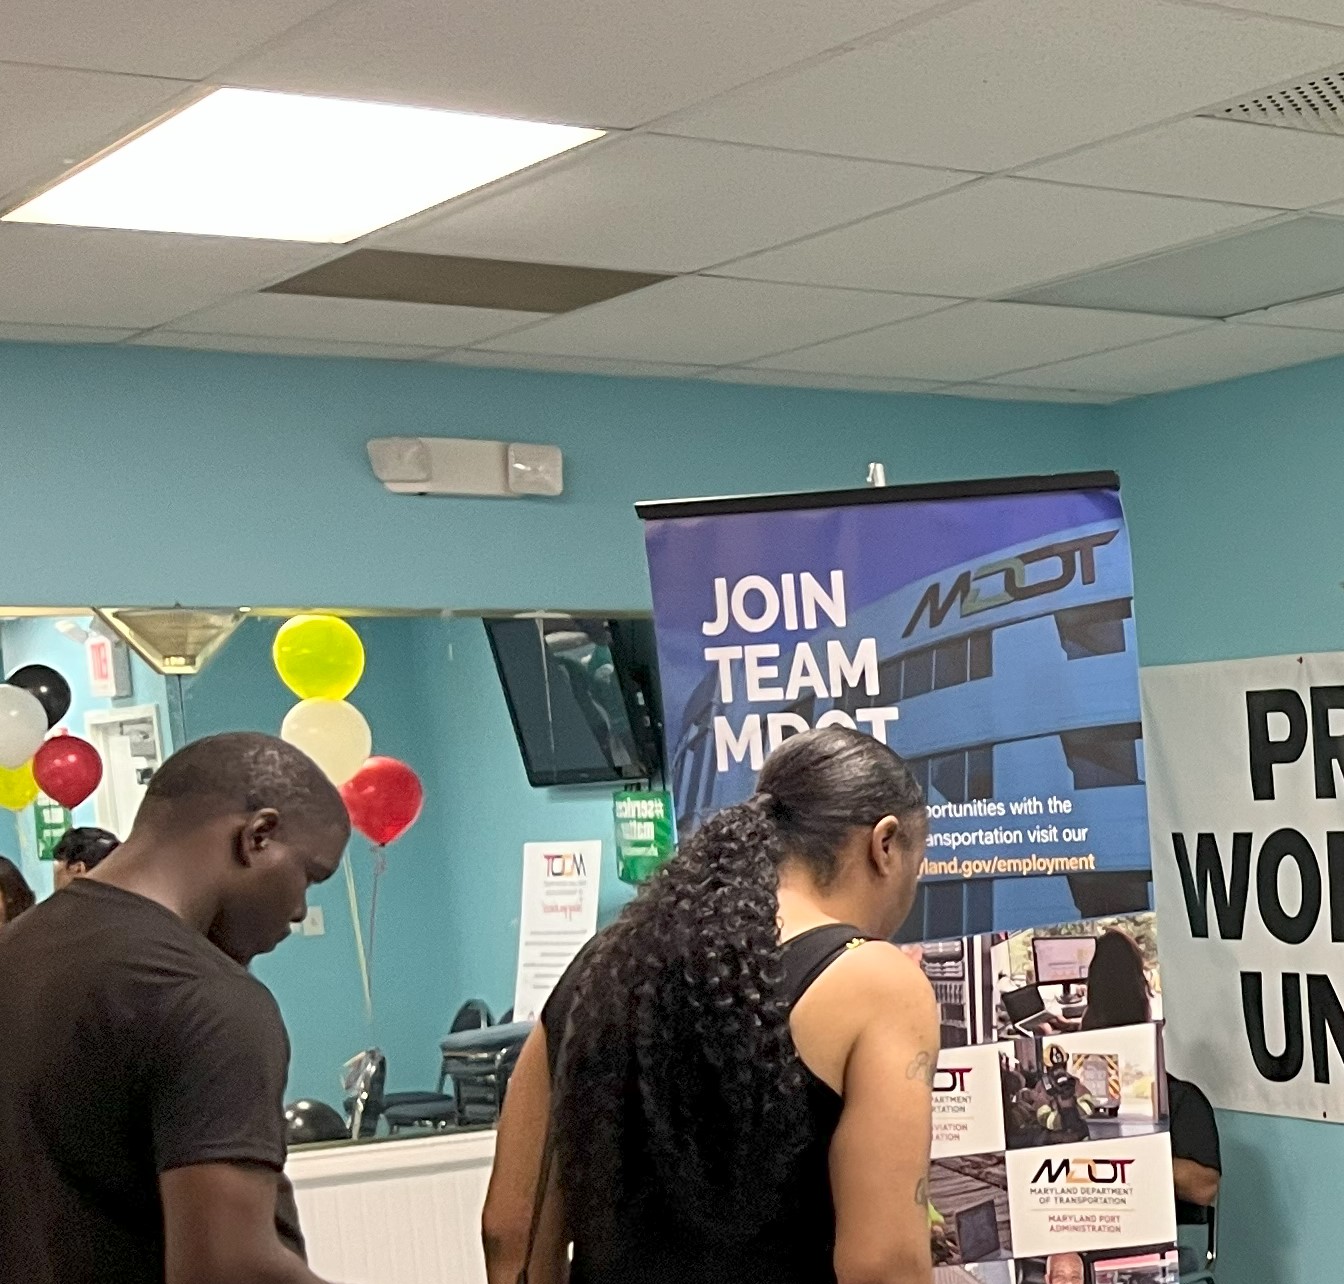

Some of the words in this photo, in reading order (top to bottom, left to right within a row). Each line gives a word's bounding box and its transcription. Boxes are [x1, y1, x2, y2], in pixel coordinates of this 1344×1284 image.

[902, 529, 1119, 638] MDOT
[702, 570, 847, 636] JOIN
[704, 638, 880, 703] TEAM
[714, 706, 898, 772] MDT
[926, 799, 1005, 818] portunities
[1010, 797, 1043, 815] with
[1048, 796, 1072, 813] the
[926, 826, 1022, 850] ansportation
[1027, 825, 1058, 843] visit
[1062, 827, 1088, 841] our
[932, 1068, 972, 1092] OT
[1031, 1158, 1136, 1184] MDOT
[1030, 1187, 1078, 1195] MARYLAND
[1080, 1187, 1133, 1195] DEPARTMENT
[1054, 1196, 1126, 1205] TRANSPORTATION
[1049, 1215, 1096, 1223] MARYLAND
[1049, 1225, 1121, 1233] ADMINISTRATION
